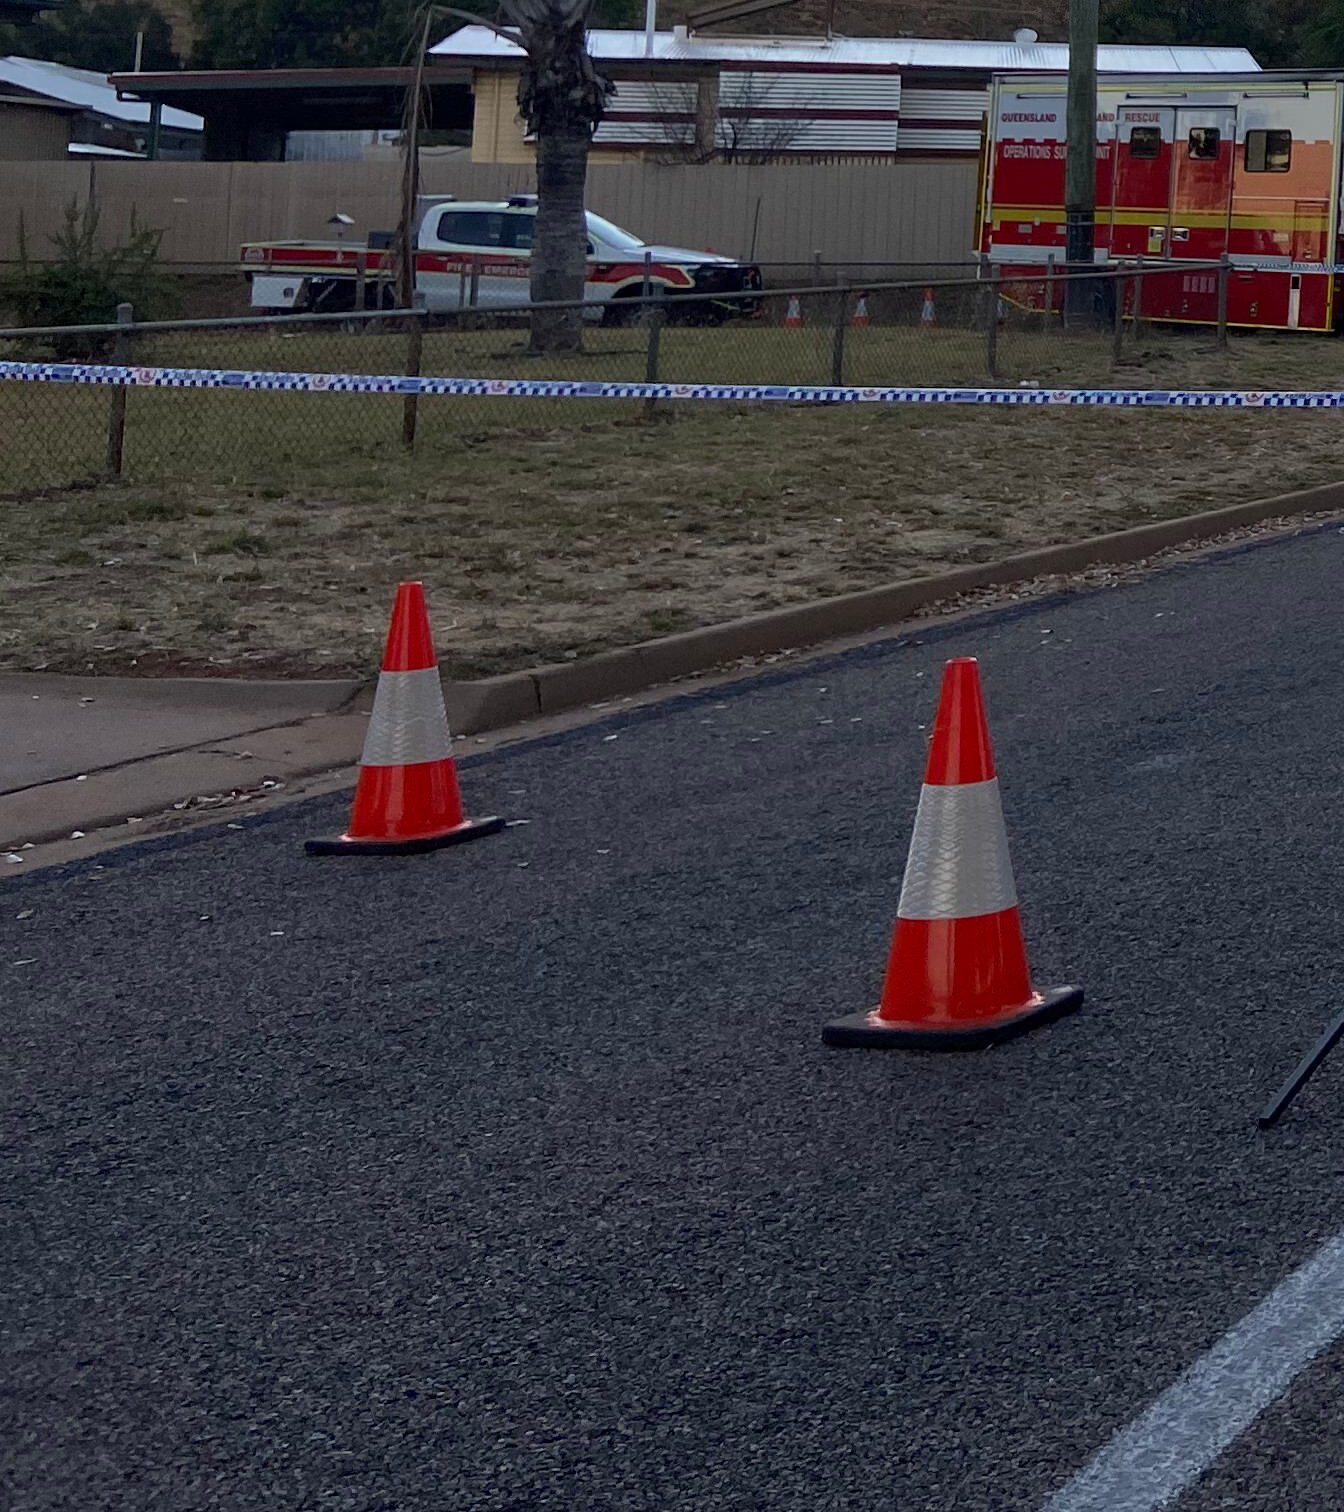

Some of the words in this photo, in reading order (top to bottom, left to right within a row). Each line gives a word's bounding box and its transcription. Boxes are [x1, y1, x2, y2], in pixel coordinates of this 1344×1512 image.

[1001, 113, 1057, 122] QUEENSLAND
[1125, 112, 1160, 122] RESCUE
[1003, 145, 1051, 159] OPERATIONS
